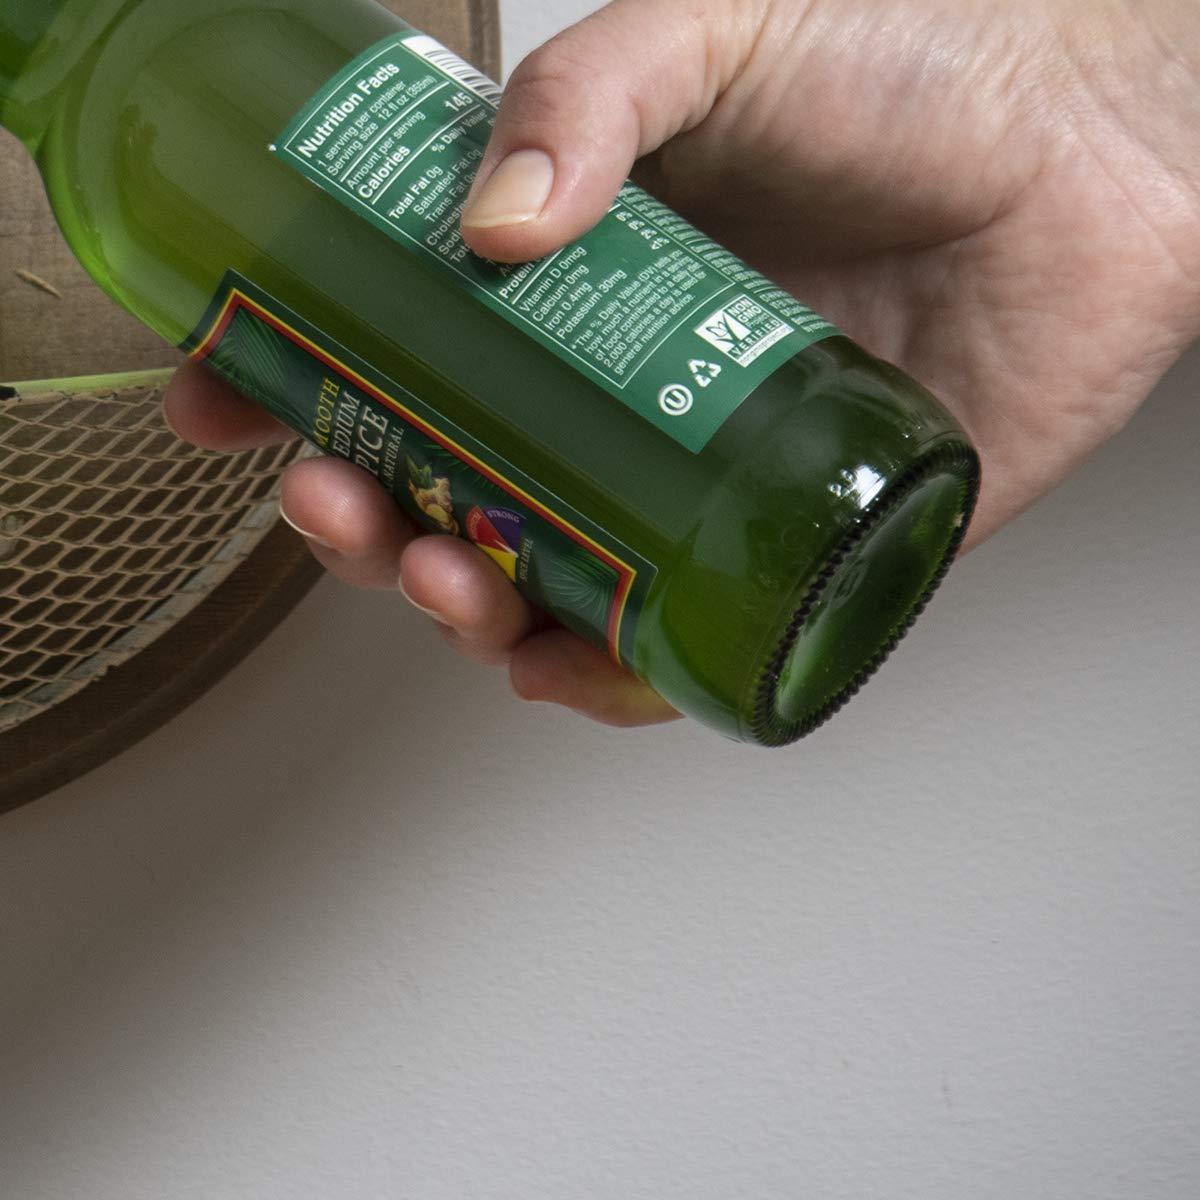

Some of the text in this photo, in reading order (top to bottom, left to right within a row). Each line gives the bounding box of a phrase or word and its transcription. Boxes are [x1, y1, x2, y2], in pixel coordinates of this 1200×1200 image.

[298, 63, 399, 156] Nutrition Facts
[317, 81, 405, 167] 1 serving per container
[327, 75, 436, 175] Serving size 12 fl oz (355ml)
[430, 143, 445, 152] %
[440, 126, 464, 144] Daily
[346, 111, 425, 189] Amount per serving
[358, 91, 472, 197] Calories 145
[389, 165, 443, 218] Total Fat 0g
[413, 148, 483, 214] Saturated Fat 0g
[424, 197, 451, 222] Trans
[447, 181, 465, 197] Fat
[437, 228, 462, 255] Sodi
[449, 241, 470, 262] Tot
[498, 263, 533, 298] Protein
[519, 277, 553, 311] Vitamin
[549, 267, 561, 278] D
[558, 246, 586, 269] 0mcg
[532, 264, 589, 321] Calcium 0mg
[543, 282, 592, 330] Iron 0.4mg
[556, 269, 627, 338] Potassium 30mg
[598, 299, 621, 319] Daily
[616, 280, 640, 299] Value
[637, 265, 658, 282] (DV)
[625, 313, 654, 342] calories
[658, 295, 675, 308] day
[679, 275, 697, 290] used
[727, 299, 752, 316] NON
[584, 334, 603, 353] how
[601, 312, 623, 335] much
[627, 281, 656, 307] nutrient
[652, 275, 663, 283] in
[595, 348, 605, 360] of
[601, 329, 622, 350] food
[657, 286, 668, 294] to
[614, 293, 695, 374] general nutrition advice.
[731, 318, 780, 355] VERIFIED
[737, 305, 761, 322] GMO
[314, 378, 338, 443] MOOTH
[333, 391, 359, 455] EDIUM
[356, 406, 387, 473] PICE
